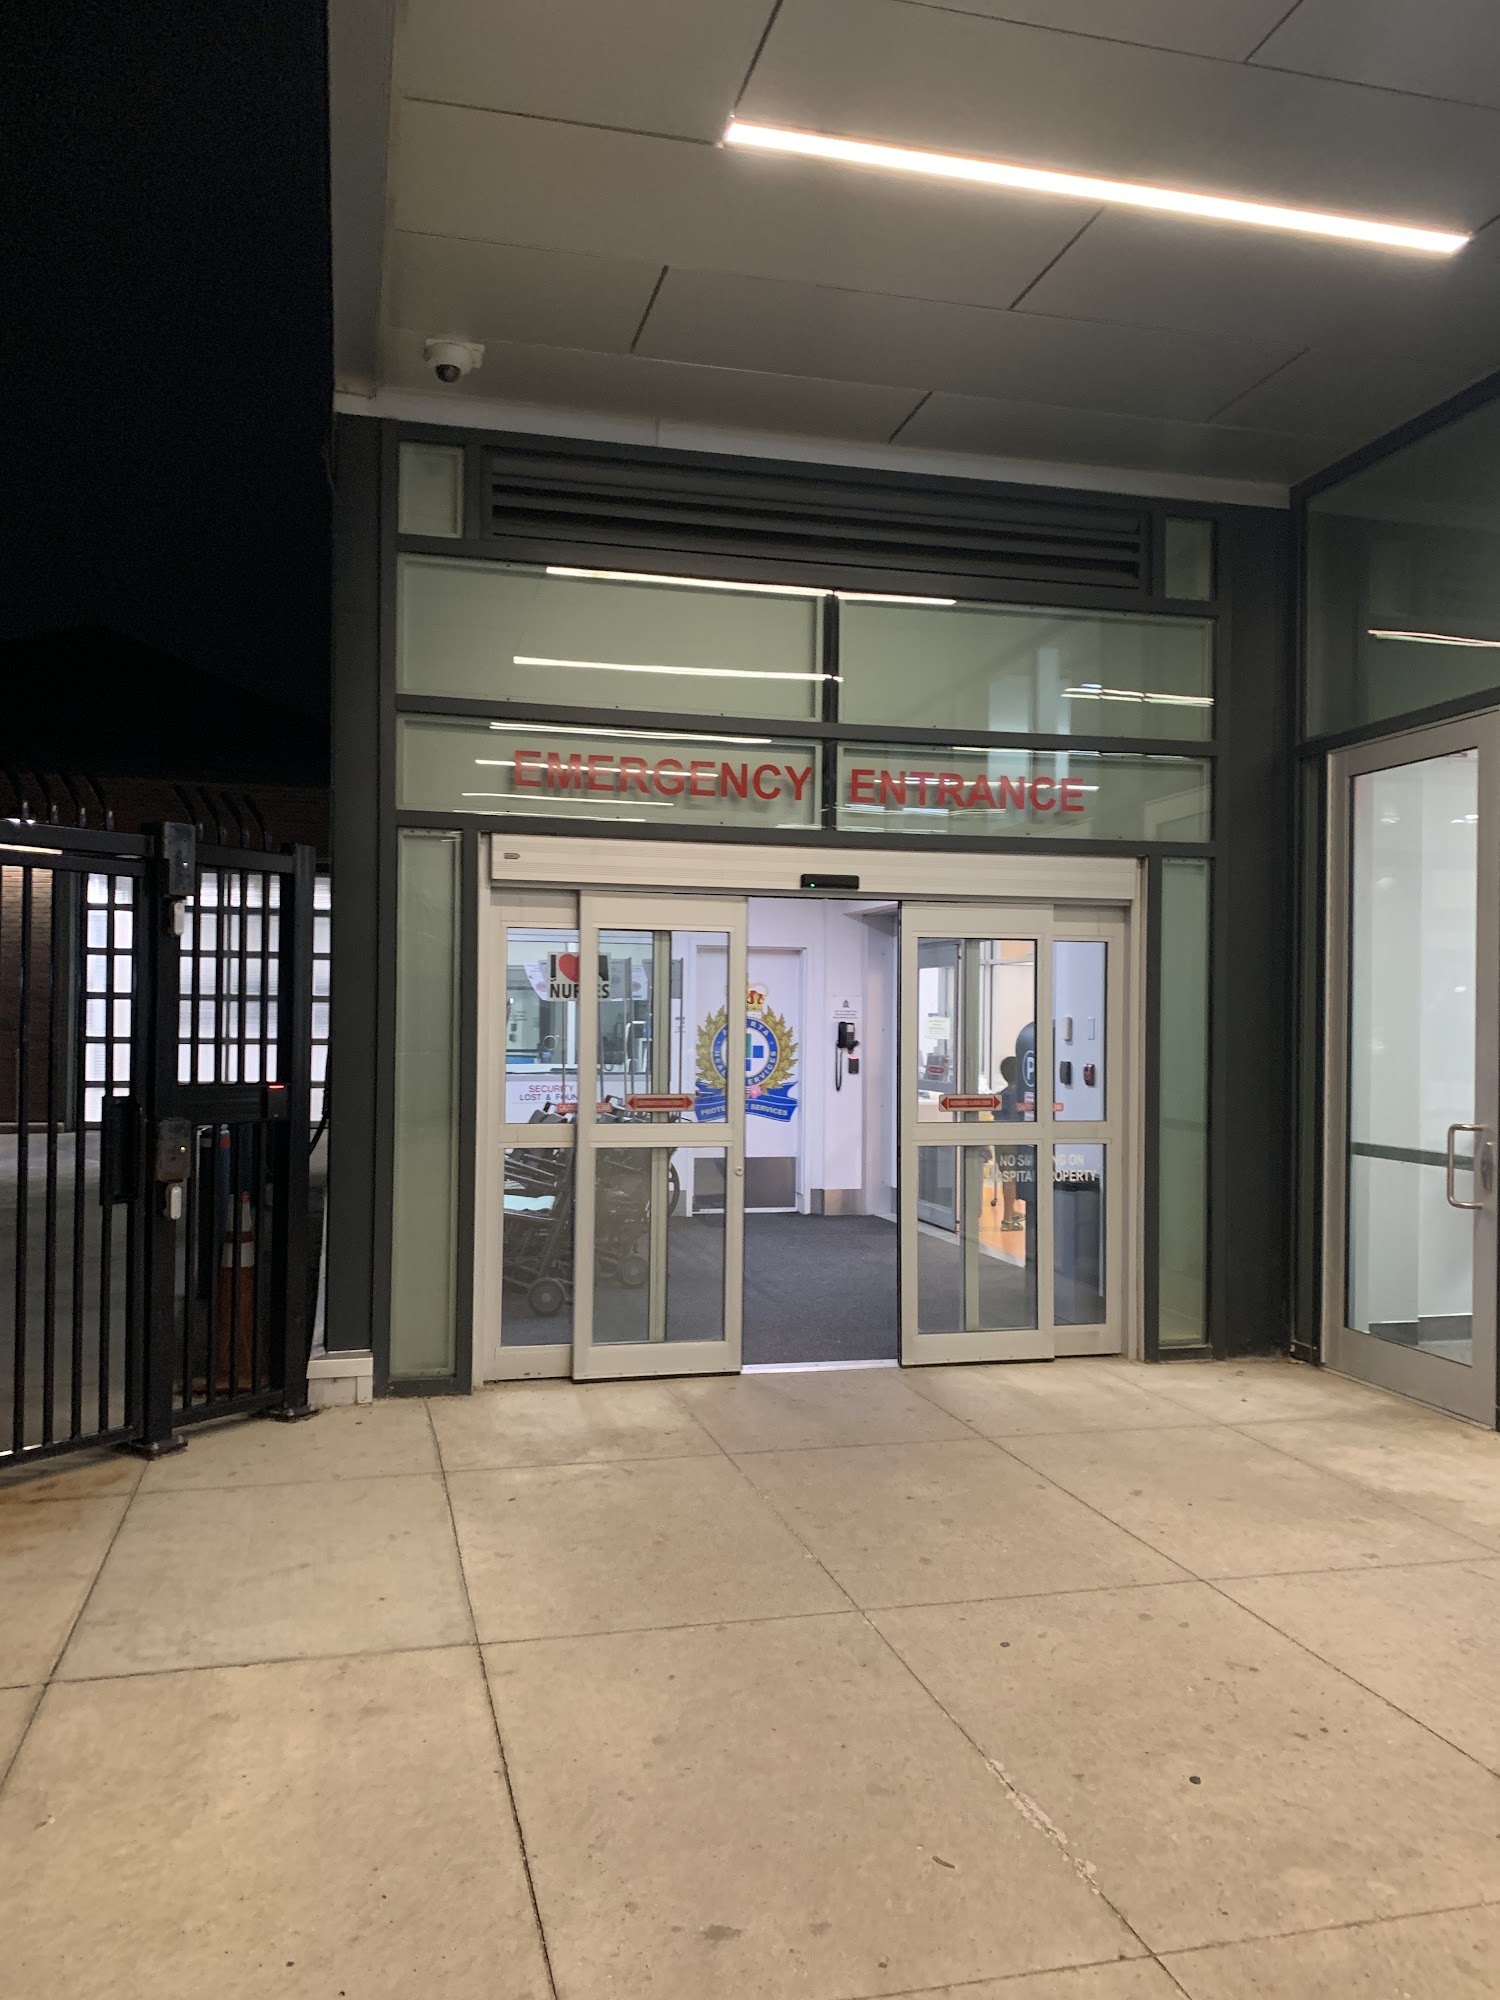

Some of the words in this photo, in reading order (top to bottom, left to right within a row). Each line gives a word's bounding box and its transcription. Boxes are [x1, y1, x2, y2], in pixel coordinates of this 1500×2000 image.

[513, 750, 812, 802] EMERGENCY
[851, 768, 1085, 812] ENTRANCE
[519, 1093, 536, 1101] LOST
[555, 1093, 578, 1101] FOUN
[1000, 1154, 1016, 1166] NO
[1053, 1169, 1097, 1182] OPERTY
